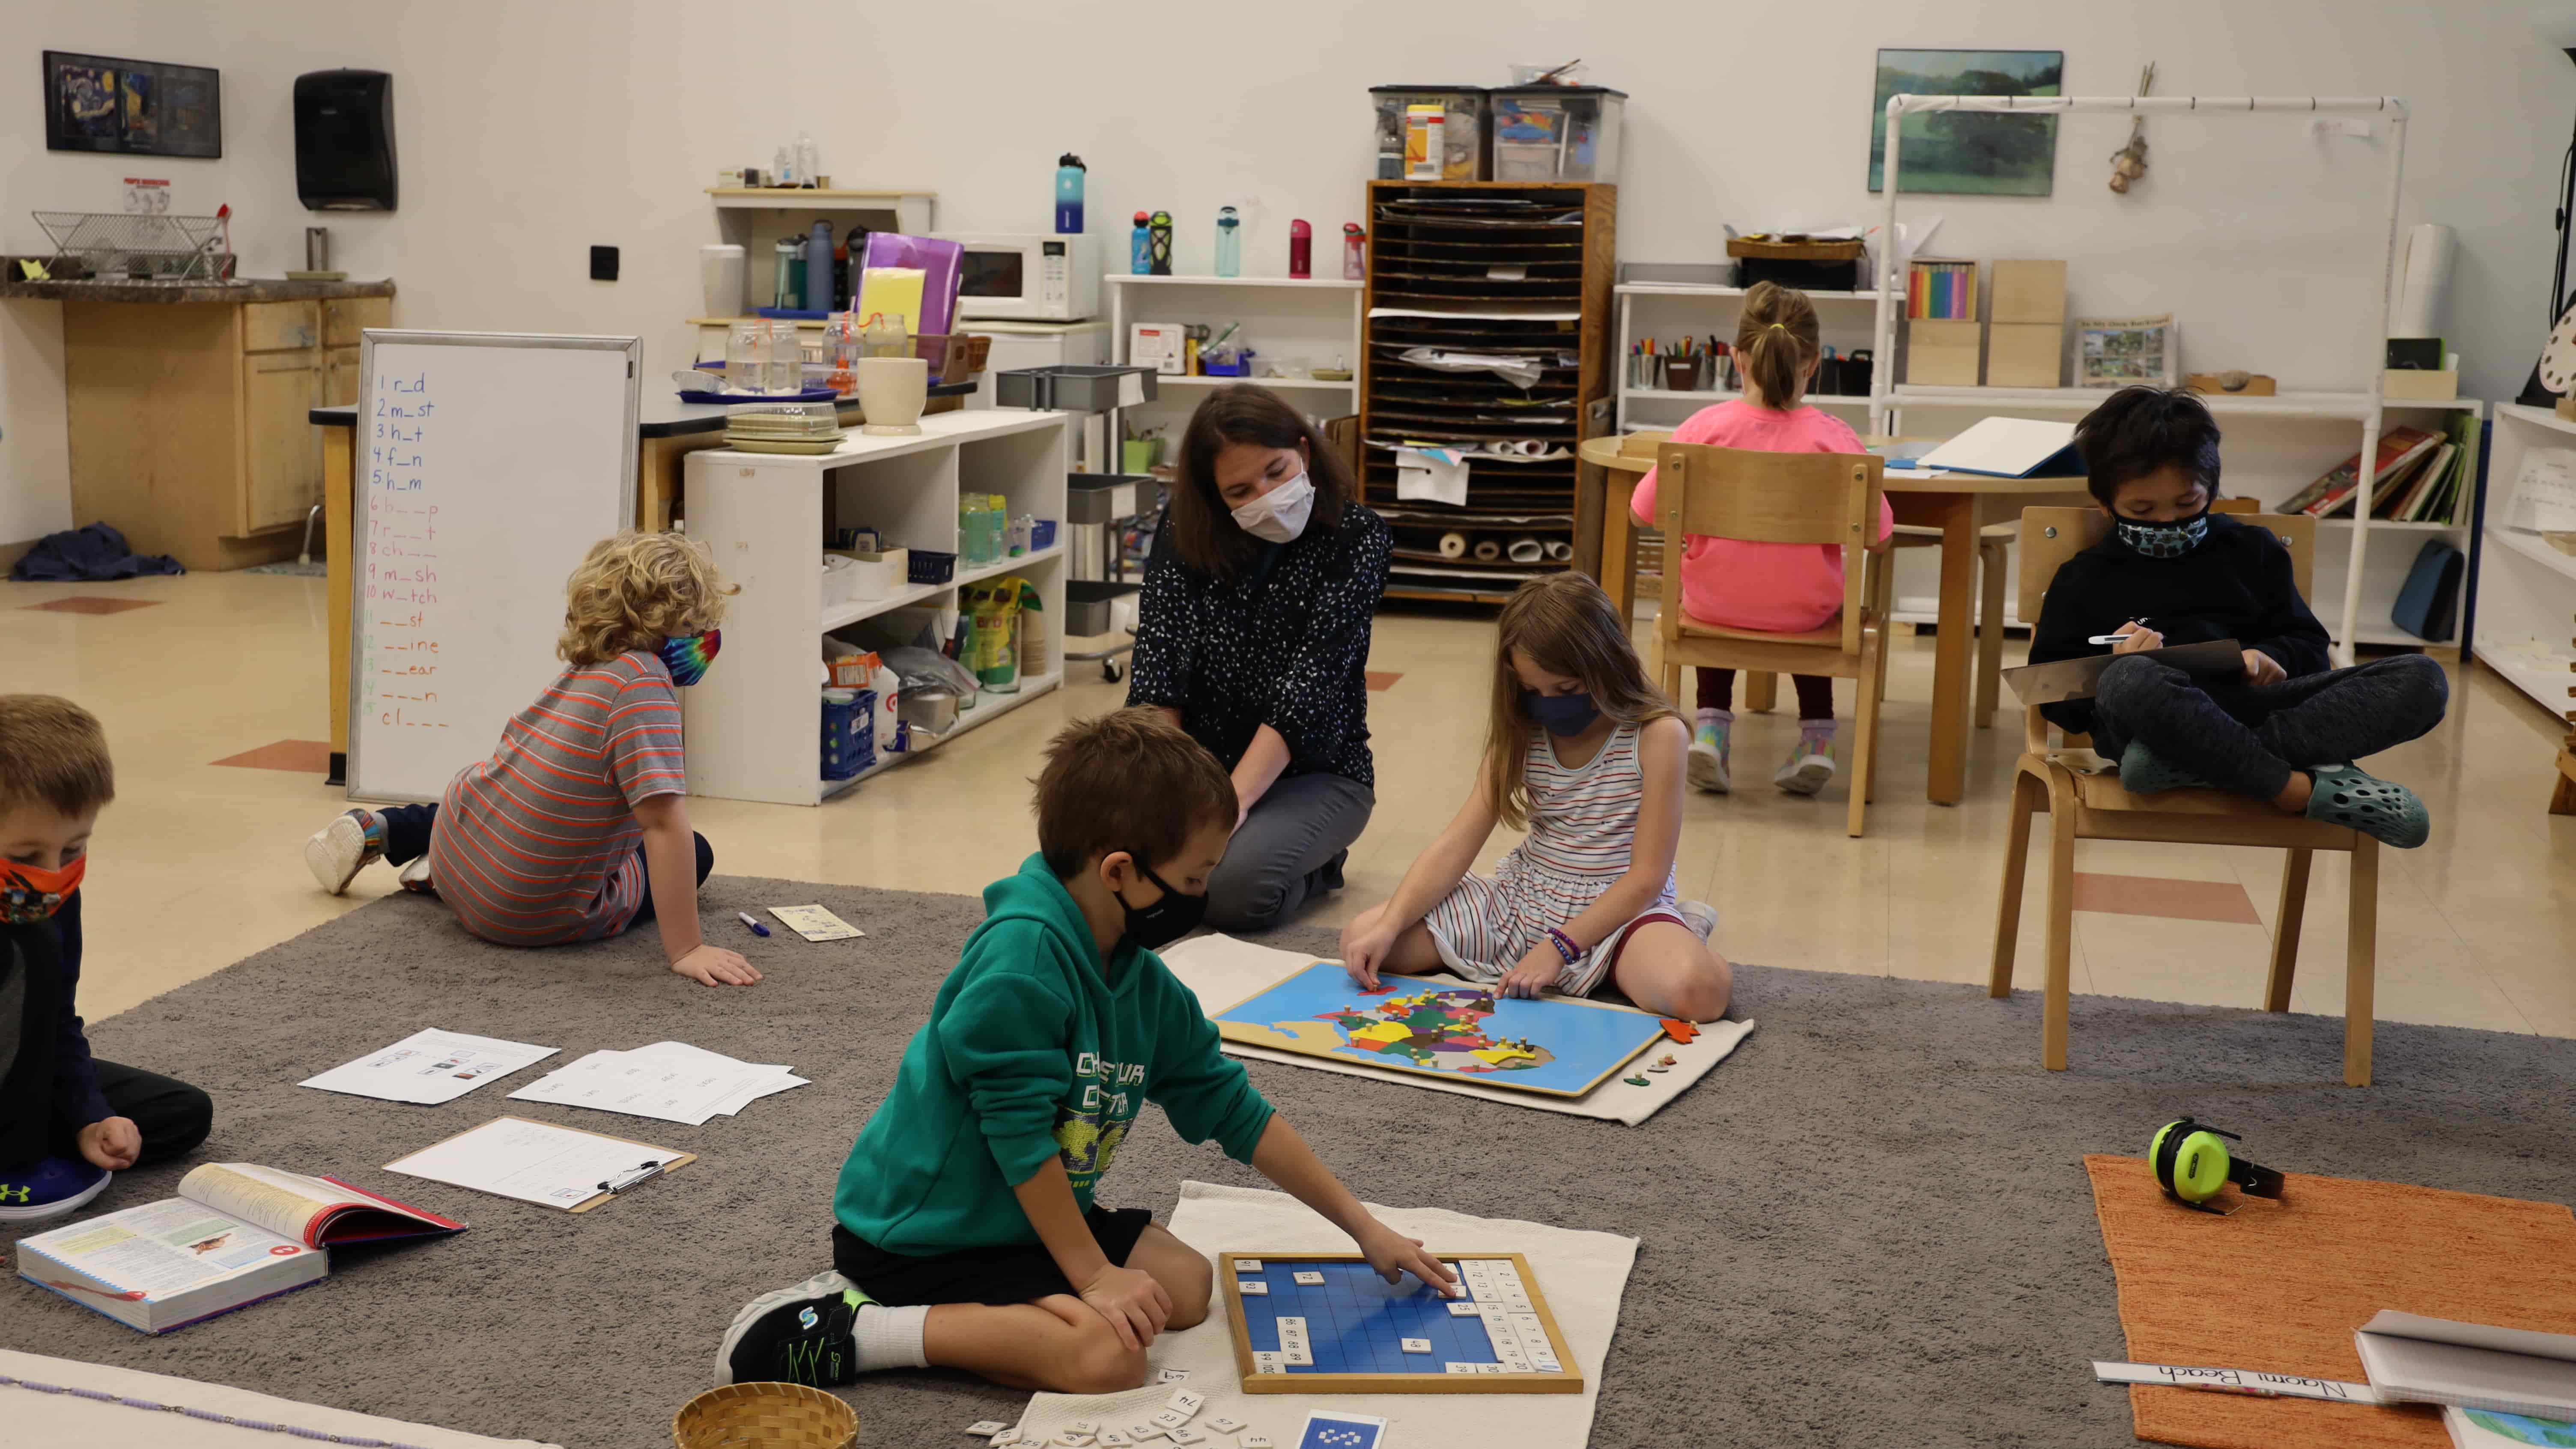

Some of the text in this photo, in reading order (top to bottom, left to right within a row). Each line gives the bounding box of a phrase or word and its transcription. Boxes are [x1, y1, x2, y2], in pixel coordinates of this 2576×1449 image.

[381, 372, 425, 393] 1 r_d
[377, 398, 385, 416] 2
[377, 423, 423, 442] 3 h_t
[373, 447, 422, 467] 4 f_n
[373, 469, 422, 490] 5 h_m
[370, 495, 378, 510] 6
[370, 520, 378, 535] 7
[370, 541, 377, 555] 8
[368, 562, 437, 583] 9 m_sh
[366, 584, 437, 604] 10 w_tch
[1288, 1341, 1299, 1349] 88
[1290, 1353, 1302, 1361] 89
[1455, 1365, 1468, 1373] 39
[1486, 1365, 1500, 1373] 30
[1515, 1362, 1528, 1370] 20
[2159, 1366, 2347, 1398] Naomi Beach
[1179, 1396, 1197, 1407] 74
